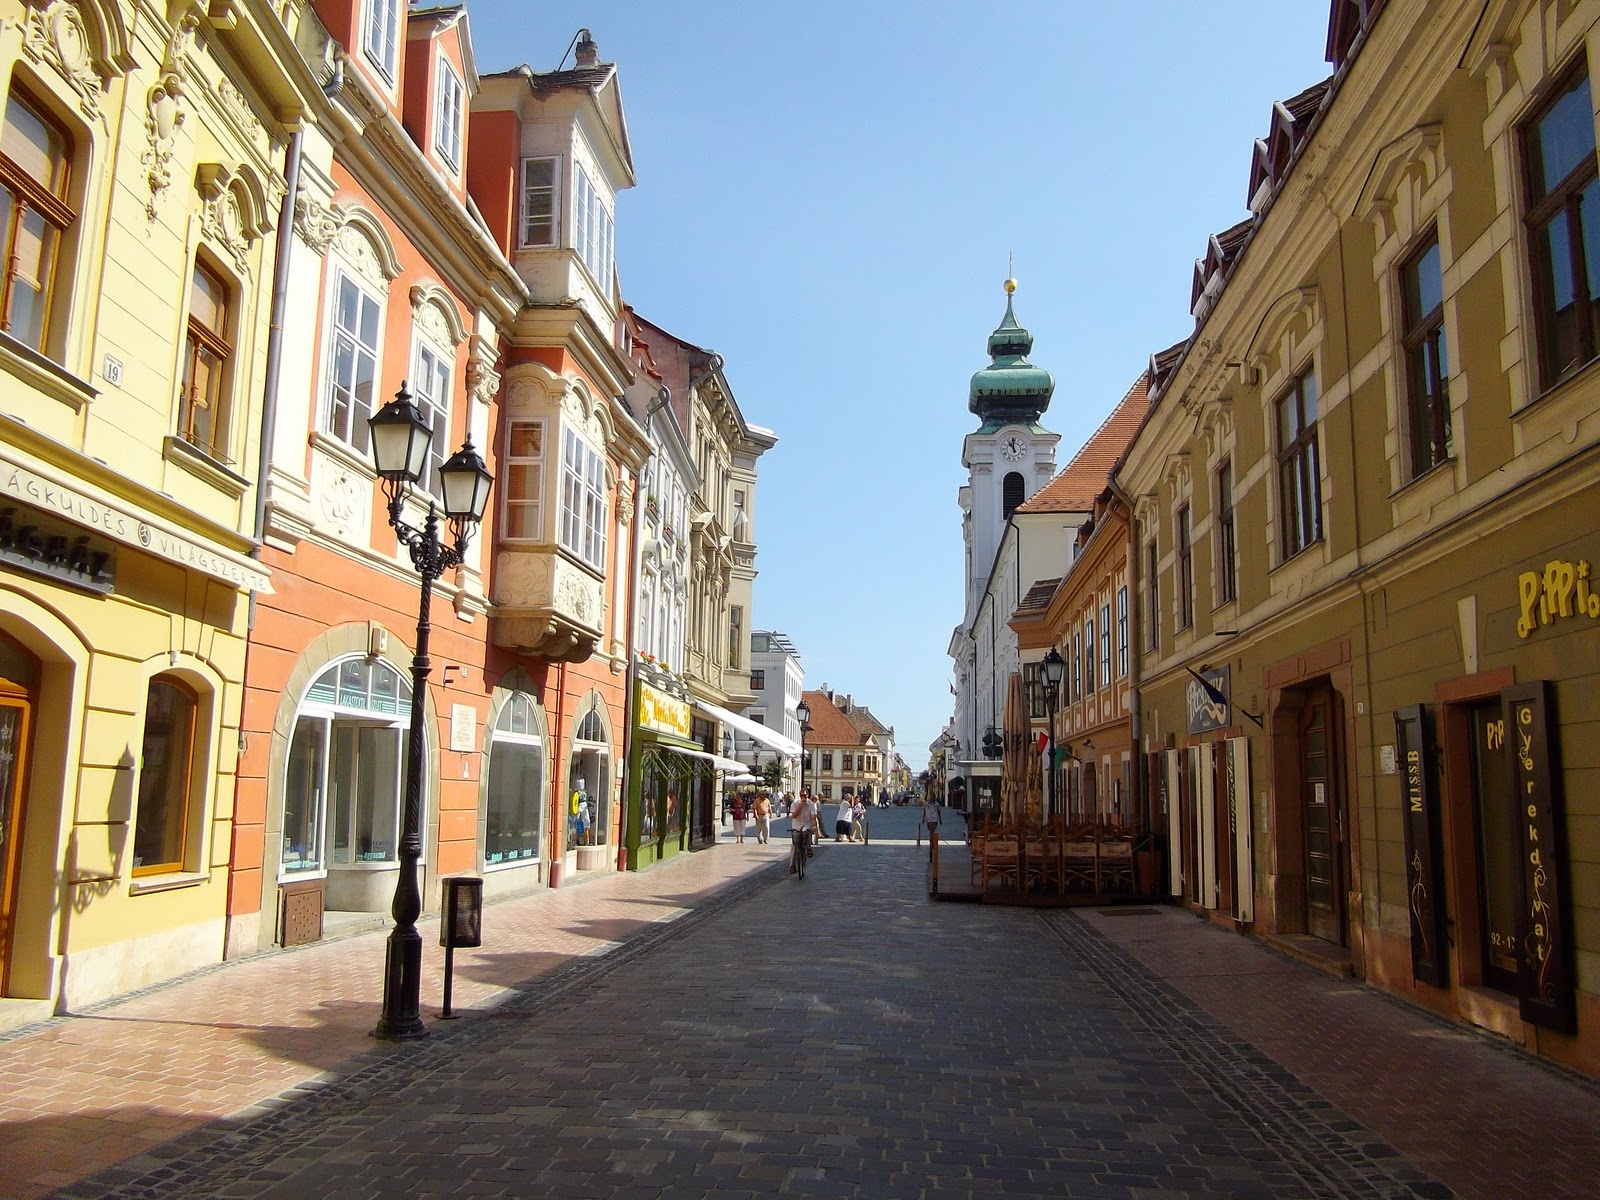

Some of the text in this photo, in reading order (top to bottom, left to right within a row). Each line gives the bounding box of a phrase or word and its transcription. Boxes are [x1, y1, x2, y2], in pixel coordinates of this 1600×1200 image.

[108, 363, 119, 382] 19
[8, 471, 267, 591] ÁGKÜLDÉS VILÁGSZERTE
[1520, 707, 1544, 961] Gyerekdivat
